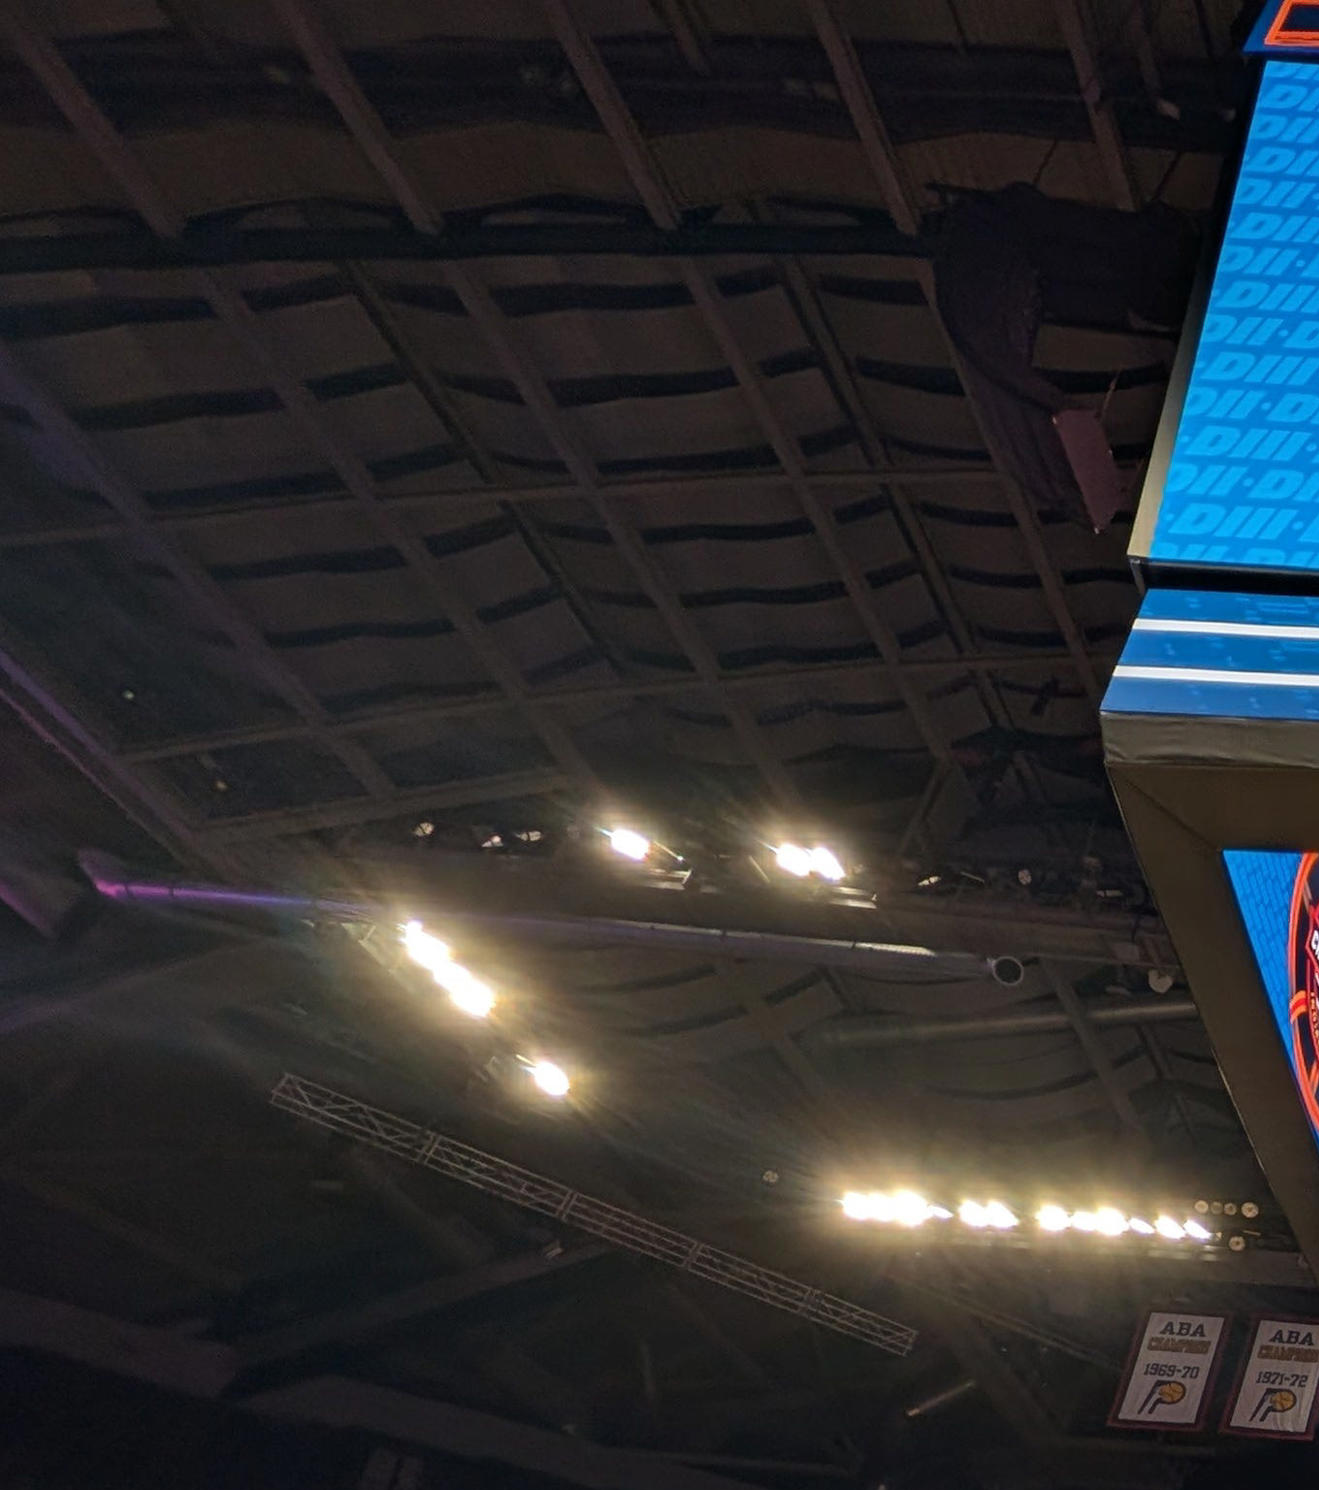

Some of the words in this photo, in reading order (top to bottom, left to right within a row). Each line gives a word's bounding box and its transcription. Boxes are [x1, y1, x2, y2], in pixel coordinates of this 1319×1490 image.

[1159, 1321, 1207, 1338] ABA
[1269, 1329, 1315, 1346] ABA
[1143, 1362, 1201, 1380] 1969-70
[1256, 1370, 1308, 1388] 1971-72
